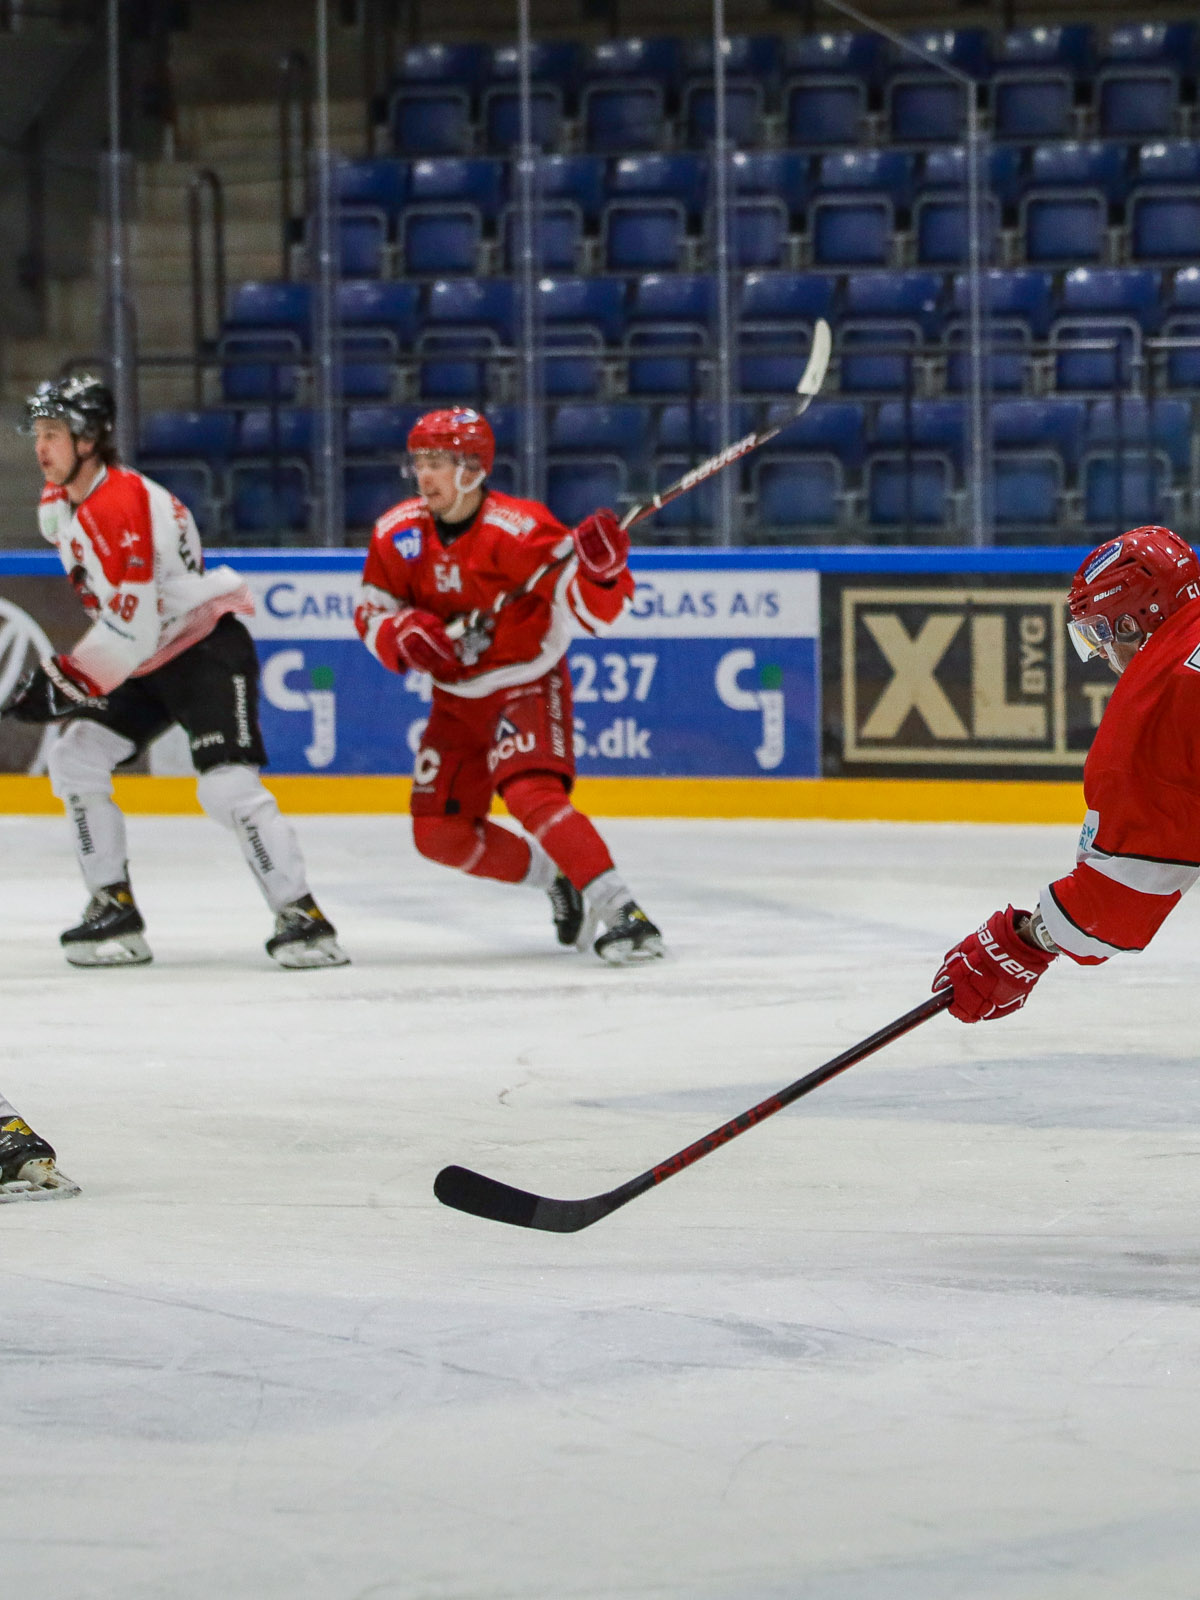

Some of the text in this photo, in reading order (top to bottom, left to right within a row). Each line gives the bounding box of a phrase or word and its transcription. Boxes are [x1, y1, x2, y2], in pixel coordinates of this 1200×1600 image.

[729, 590, 782, 619] A/S
[1092, 584, 1123, 603] BAUER
[1185, 582, 1200, 600] 51
[108, 593, 140, 623] 48
[859, 613, 1047, 740] XL BYG
[487, 731, 536, 773] DCU
[976, 920, 1039, 984] BAUER
